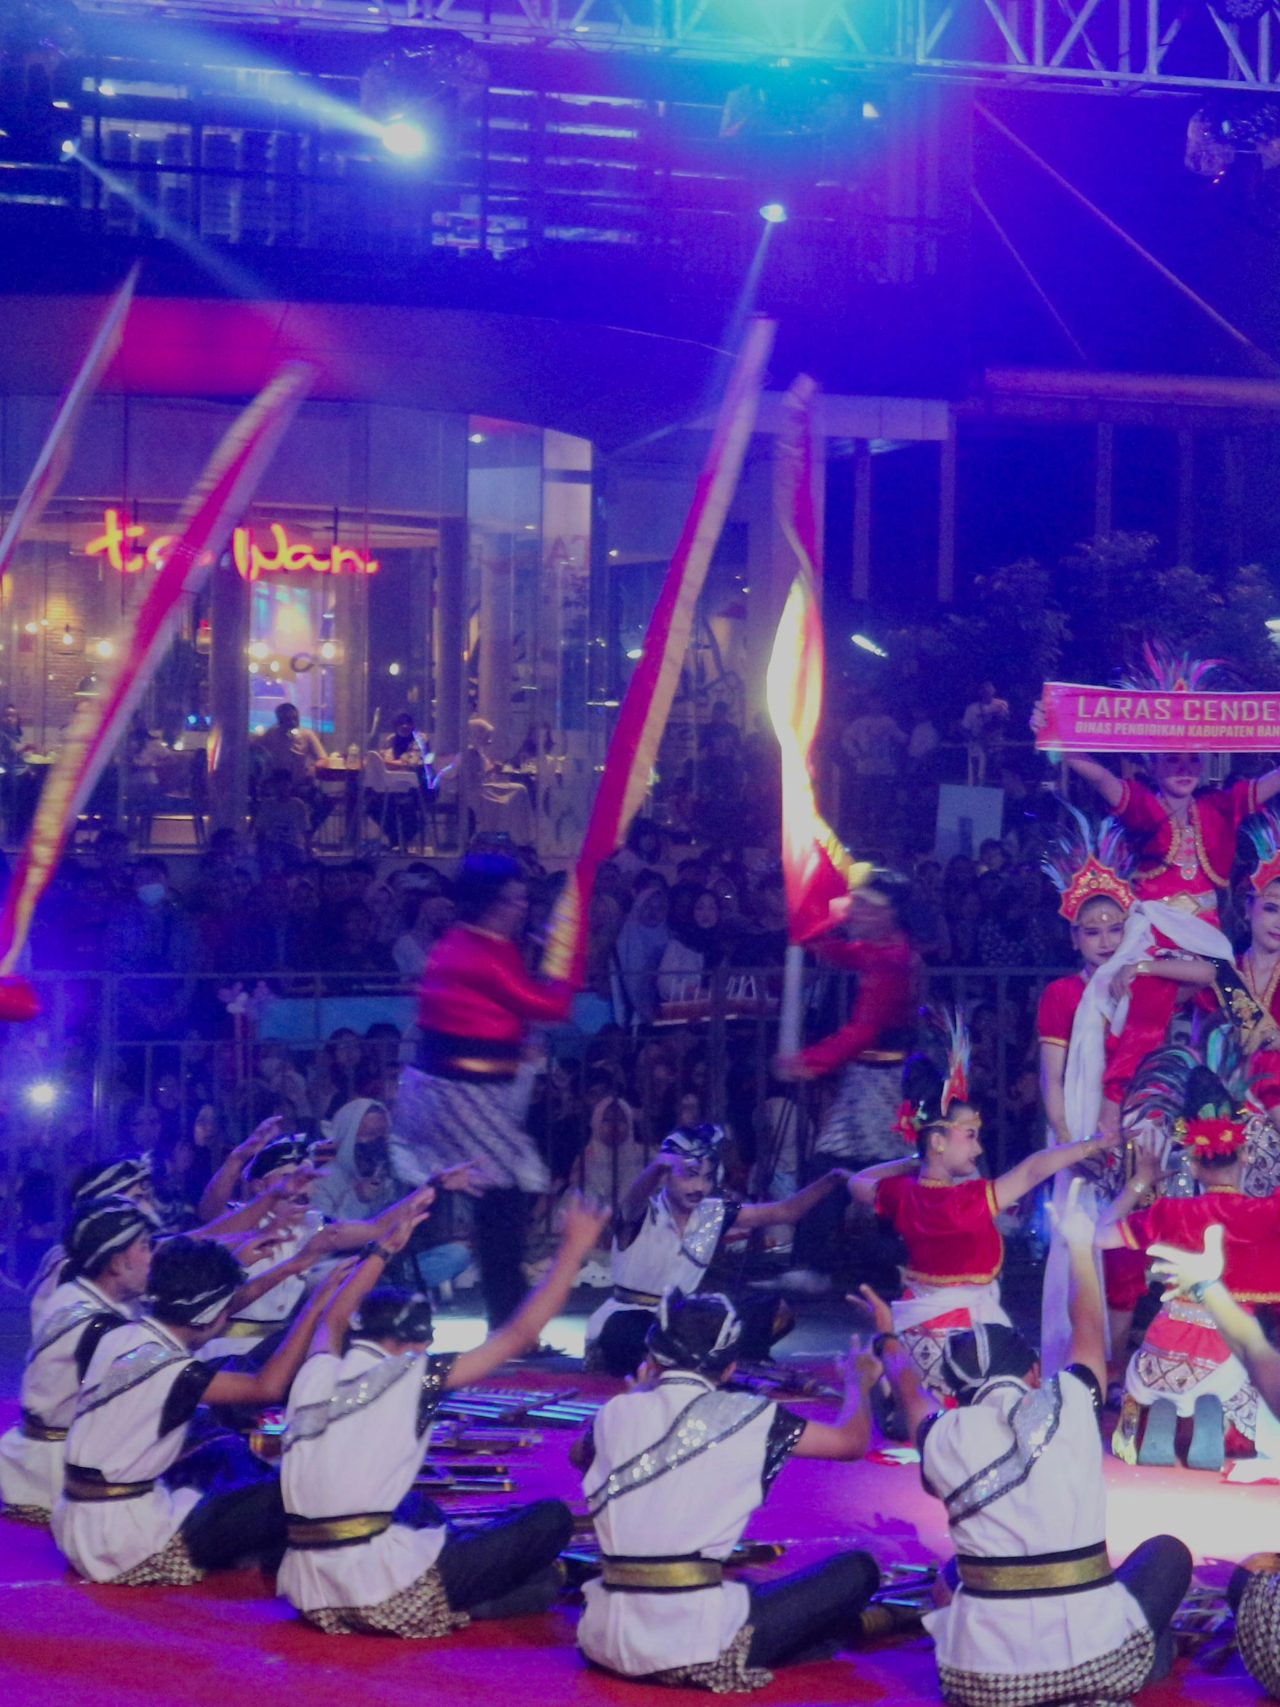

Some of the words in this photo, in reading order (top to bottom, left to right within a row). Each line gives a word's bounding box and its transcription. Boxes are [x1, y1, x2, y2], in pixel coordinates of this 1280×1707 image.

[1078, 694, 1171, 721] LARAS
[1075, 721, 1113, 735] DINAS
[1114, 722, 1185, 737] PENDIDIKAN
[1187, 725, 1255, 738] KABUPATEN
